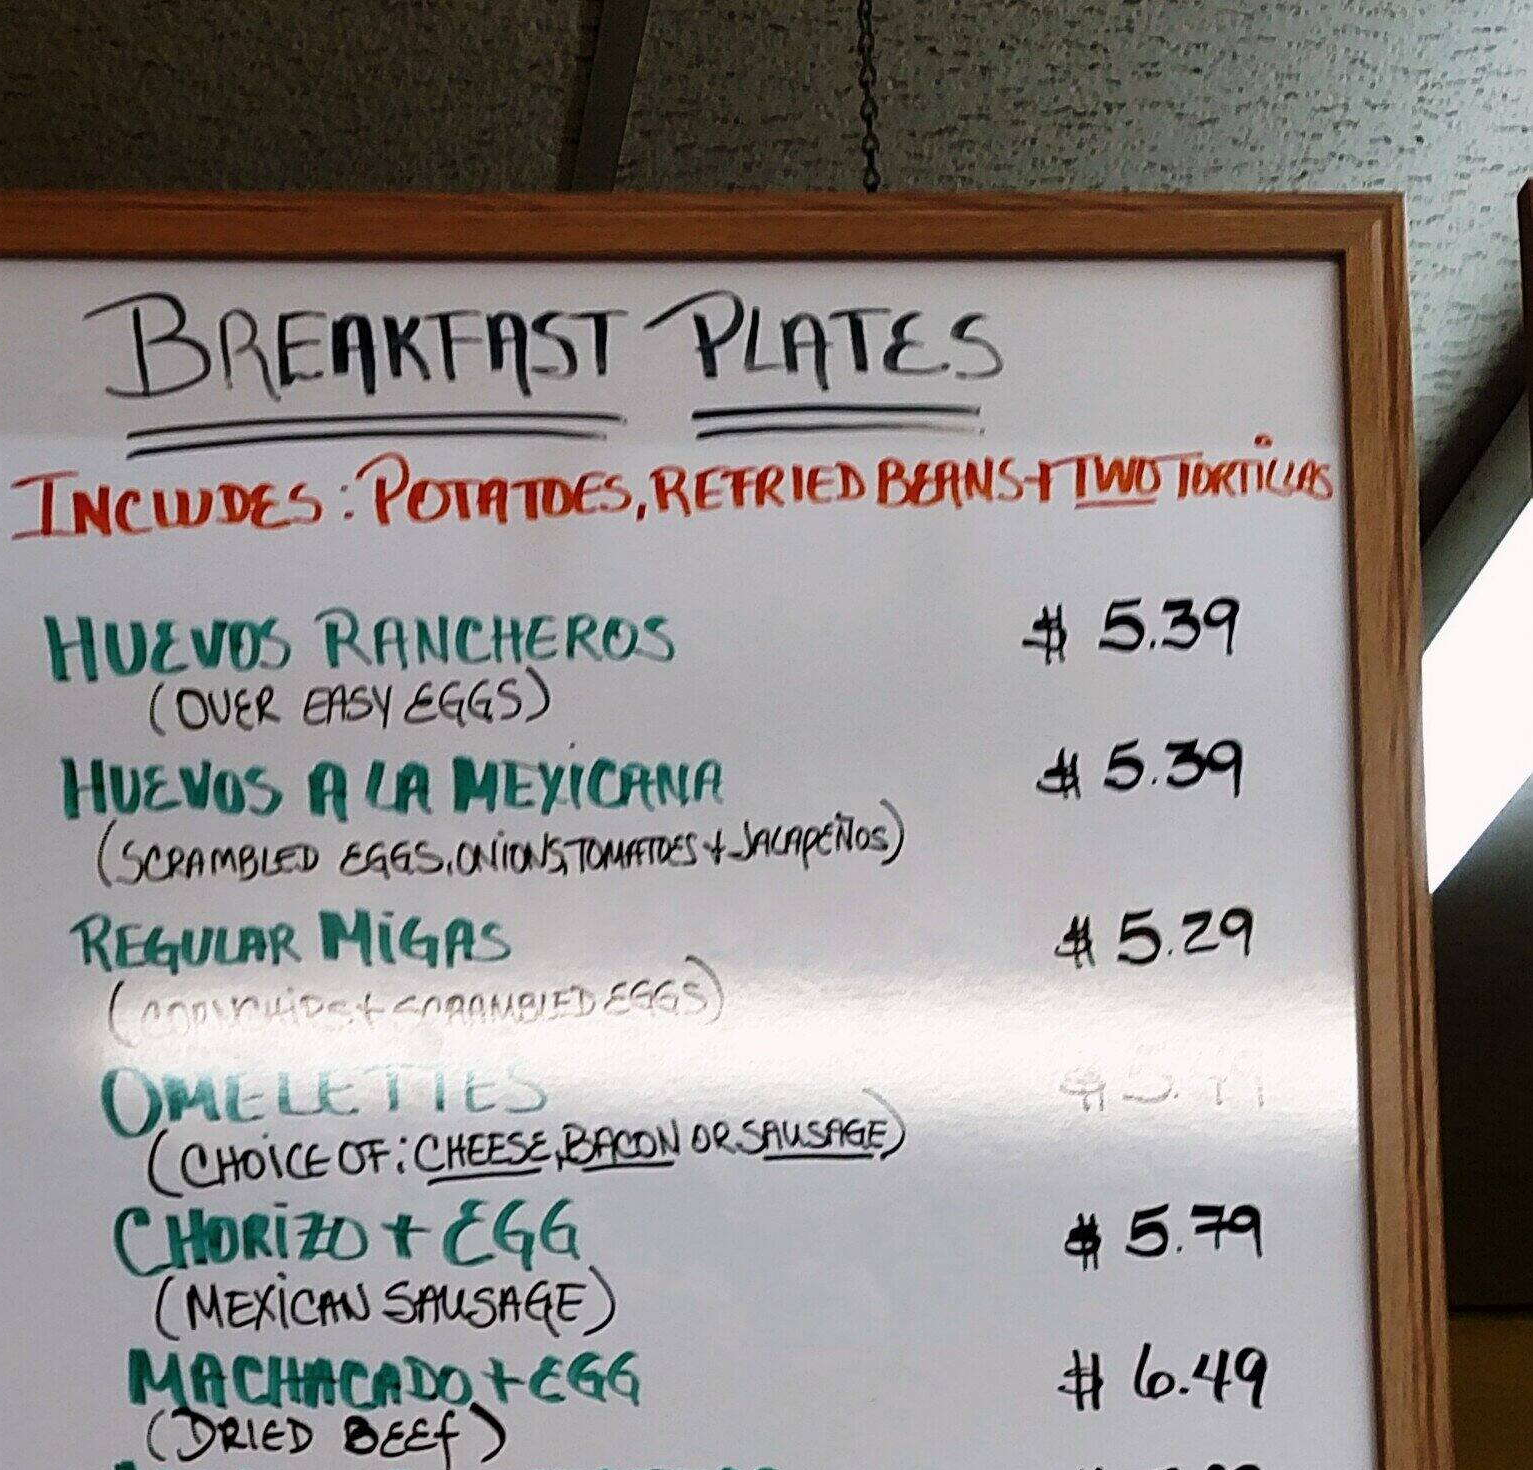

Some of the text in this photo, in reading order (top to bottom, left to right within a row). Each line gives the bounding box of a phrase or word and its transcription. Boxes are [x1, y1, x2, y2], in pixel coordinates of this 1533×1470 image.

[84, 290, 1004, 402] BREAKFAST PLATES
[649, 462, 865, 517] REFRIED
[1055, 453, 1161, 500] TWO
[1167, 433, 1333, 500] TORTILLAS
[44, 607, 674, 682] HUEVOS RANCHEROS
[303, 686, 393, 728] EASY
[61, 742, 724, 823] HUEVOS A LA MEXICANA
[69, 909, 512, 975] REGULAR MIGAS
[565, 1122, 680, 1167] BACON
[690, 1123, 741, 1156] OR
[114, 1198, 581, 1277] CHORIZO EGG
[128, 1348, 640, 1409] MACHACADO EGG
